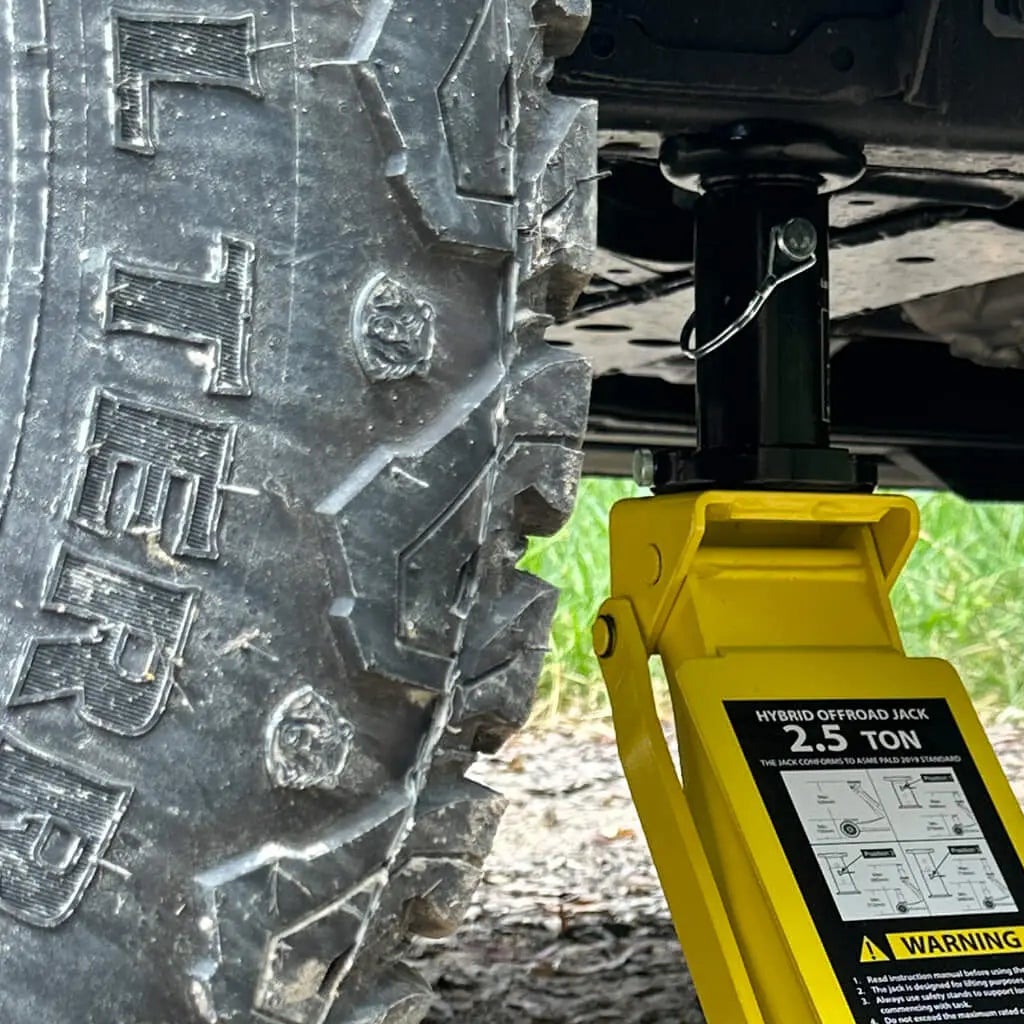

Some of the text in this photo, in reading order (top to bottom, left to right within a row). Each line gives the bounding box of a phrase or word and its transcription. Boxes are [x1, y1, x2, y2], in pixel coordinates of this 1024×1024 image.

[755, 708, 929, 722] HYBRID OFFROAD JACK
[782, 724, 922, 752] 2.5 TON
[759, 759, 777, 767] THE
[778, 758, 798, 767] JACK
[798, 757, 844, 766] CONFORMS
[843, 757, 856, 765] TO
[919, 755, 962, 764] STANDARD
[900, 930, 1022, 956] WARNING
[866, 974, 889, 984] Read
[887, 973, 933, 982] instruction
[933, 970, 964, 979] manual
[963, 969, 990, 977] before
[990, 967, 1013, 976] using
[856, 987, 866, 995] 2.
[870, 985, 888, 994] The
[887, 984, 905, 994] jack
[913, 981, 951, 992] designed
[950, 980, 963, 988] for
[962, 979, 989, 988] lifting
[988, 977, 1024, 987] purposes
[861, 997, 871, 1006] 3.
[876, 996, 905, 1004] Always
[920, 992, 945, 1001] safety
[946, 990, 973, 999] stands
[982, 988, 1015, 997] support
[880, 1000, 972, 1015] commencing with task.
[884, 1016, 898, 1024] Do
[898, 1015, 914, 1023] not
[913, 1012, 943, 1022] exceed
[942, 1012, 957, 1020] the
[957, 1010, 998, 1019] maximum
[997, 1007, 1020, 1016] rated
